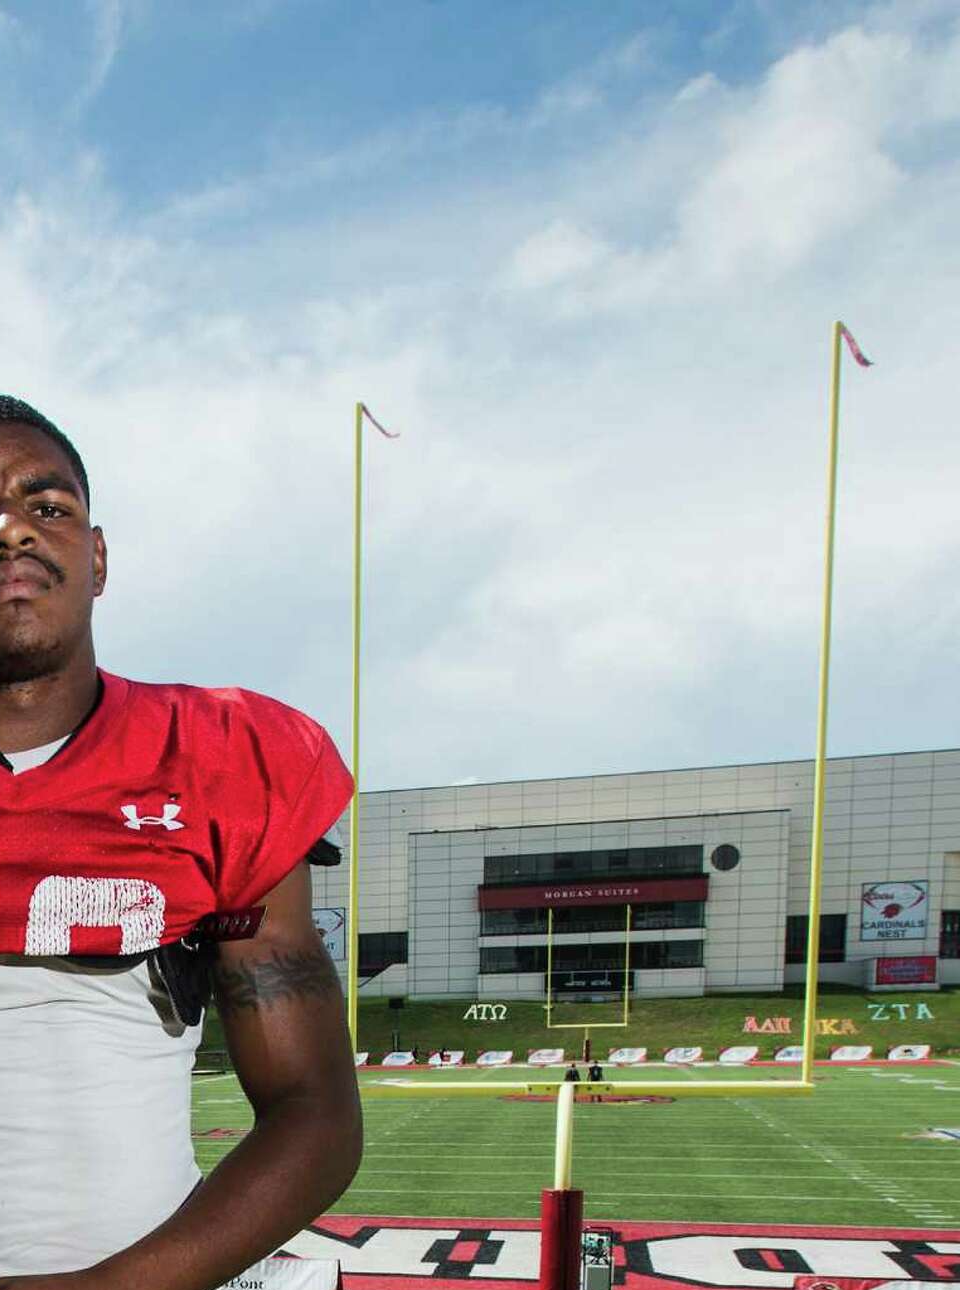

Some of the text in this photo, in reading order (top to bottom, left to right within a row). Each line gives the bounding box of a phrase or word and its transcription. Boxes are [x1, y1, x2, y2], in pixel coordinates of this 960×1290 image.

[544, 889, 593, 899] MORGAN
[862, 920, 925, 930] CARDINALS
[877, 929, 907, 938] NEST
[224, 1276, 265, 1290] Pont
